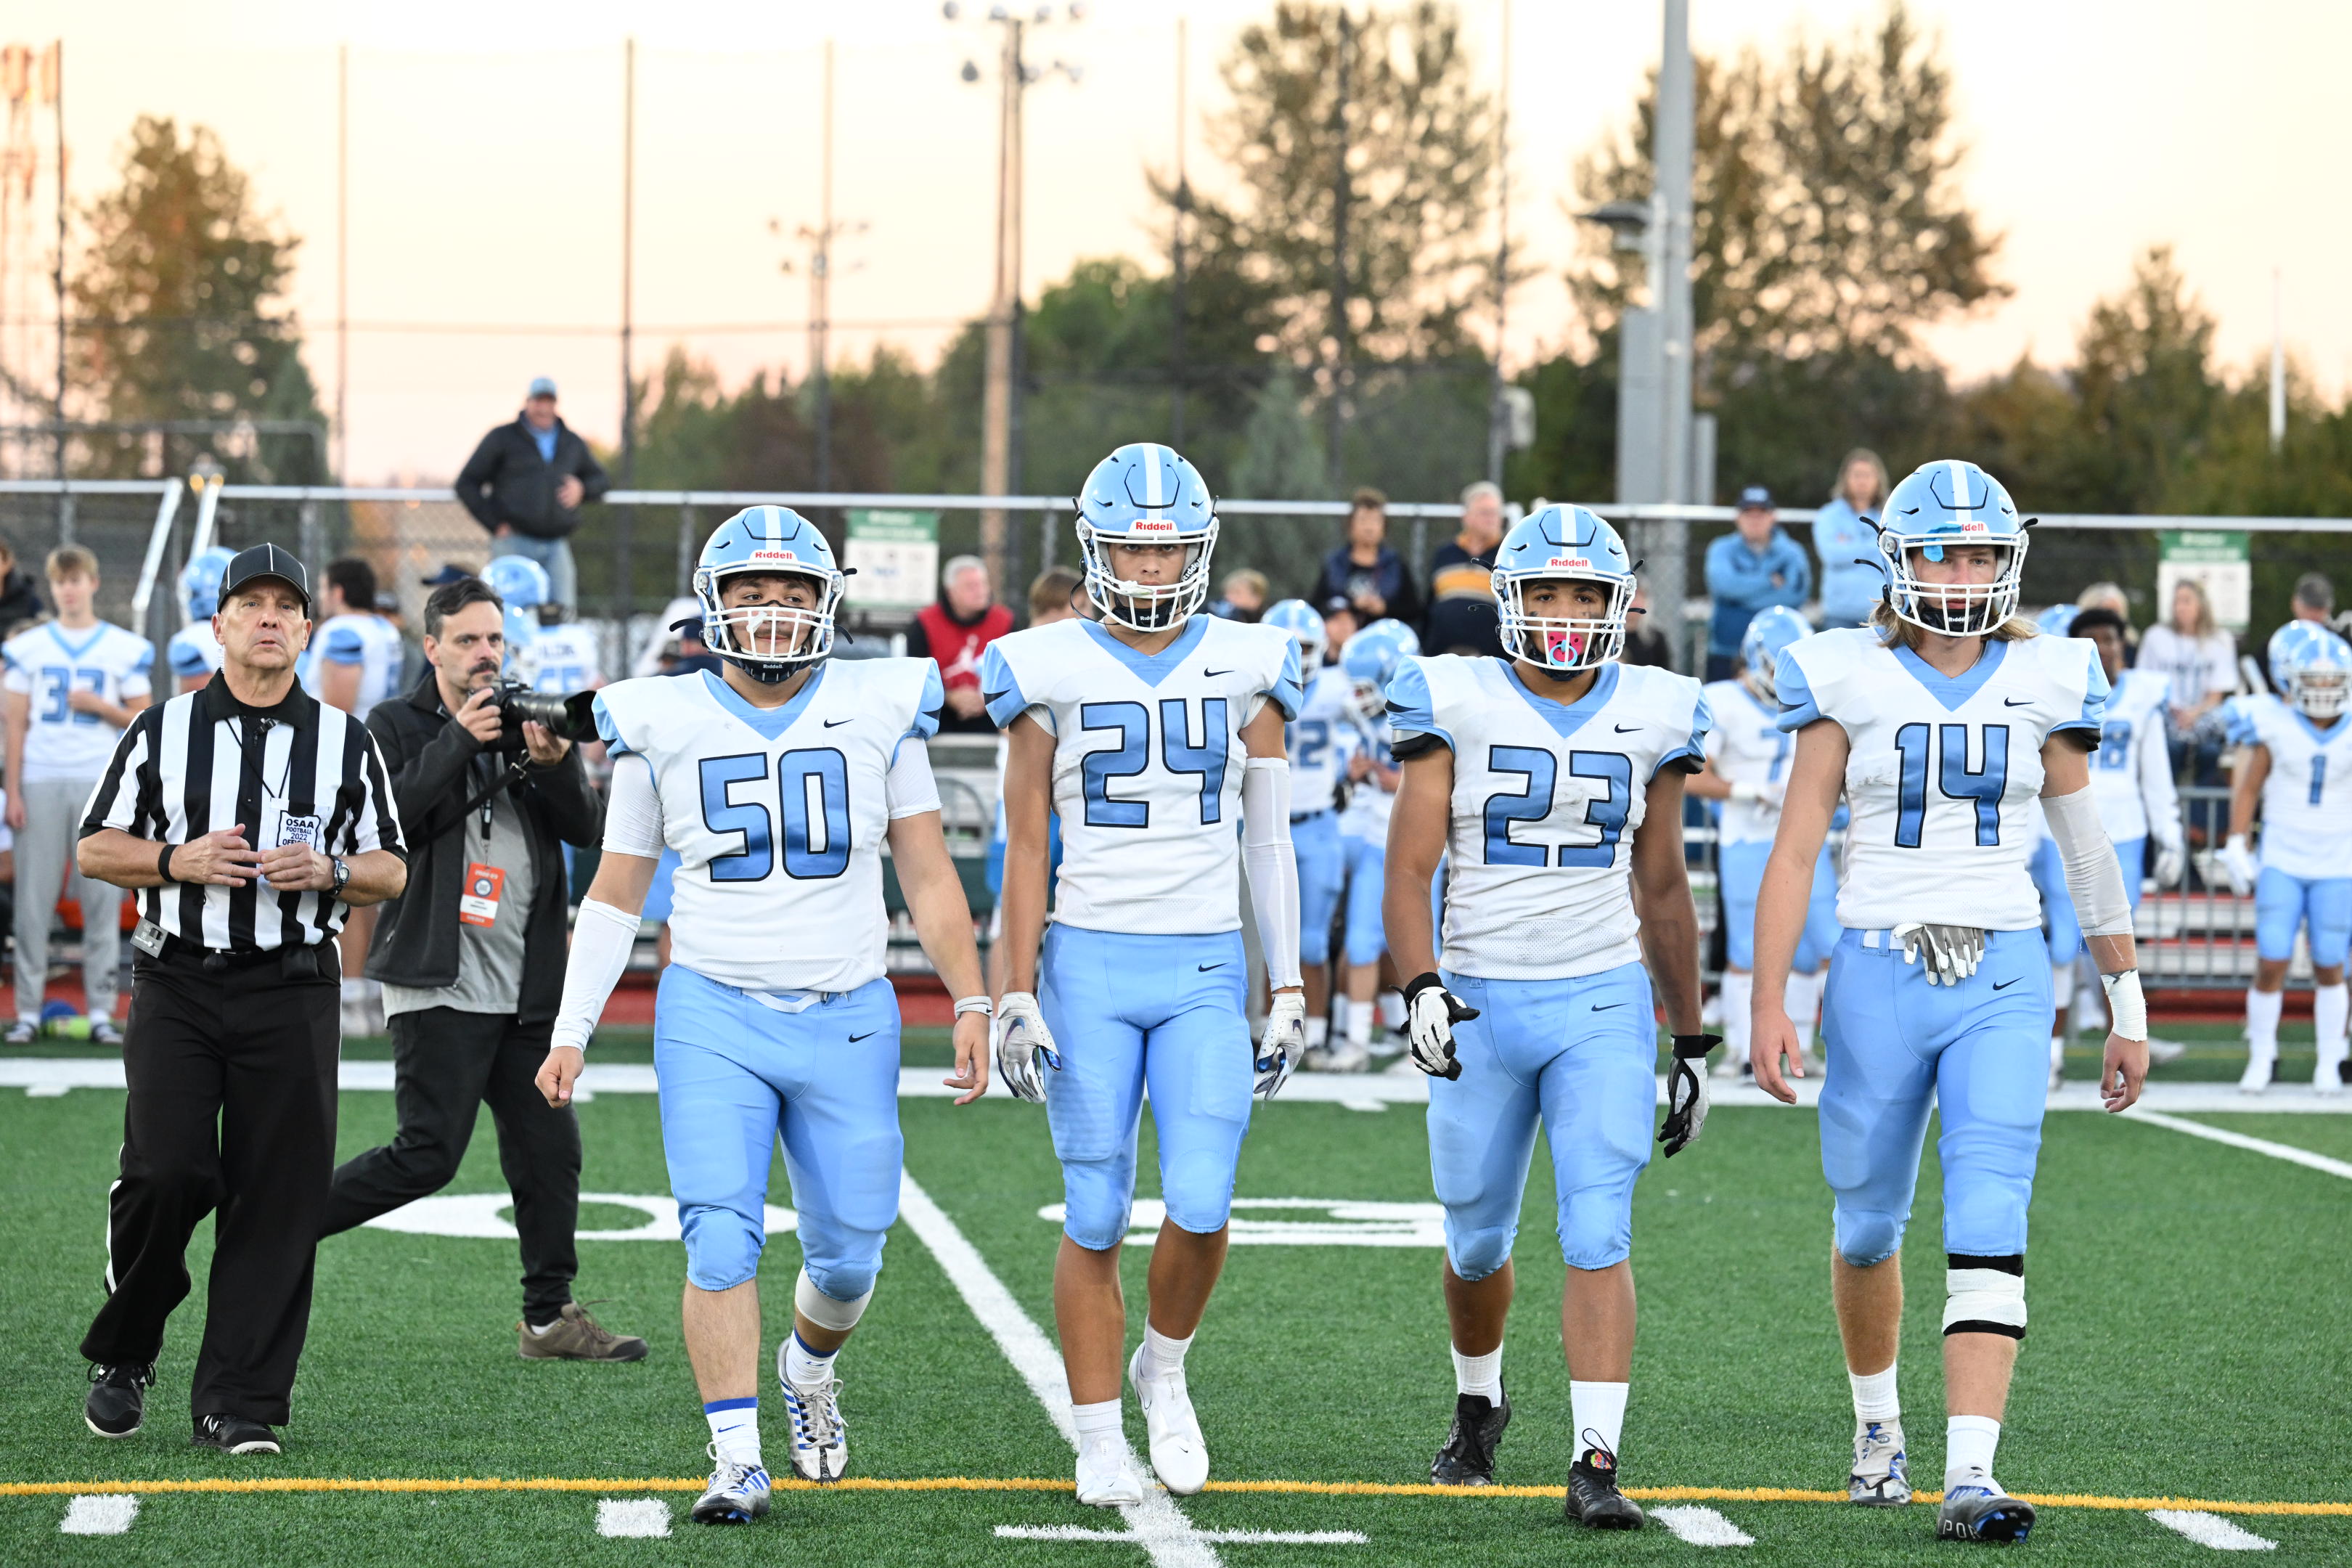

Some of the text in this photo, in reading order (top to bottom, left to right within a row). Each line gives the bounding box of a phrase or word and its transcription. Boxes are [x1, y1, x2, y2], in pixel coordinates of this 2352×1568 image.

[1135, 521, 1172, 531] Riddell
[1961, 523, 1984, 531] dell
[755, 551, 793, 560] Riddell
[1551, 558, 1588, 567] Riddell
[1080, 698, 1229, 829] 24
[2308, 754, 2327, 805] 1
[1894, 722, 2009, 849] 14
[1483, 744, 1633, 869] 23
[698, 747, 852, 883] 50
[286, 818, 314, 828] OSAA
[286, 826, 312, 835] FOOTBALL
